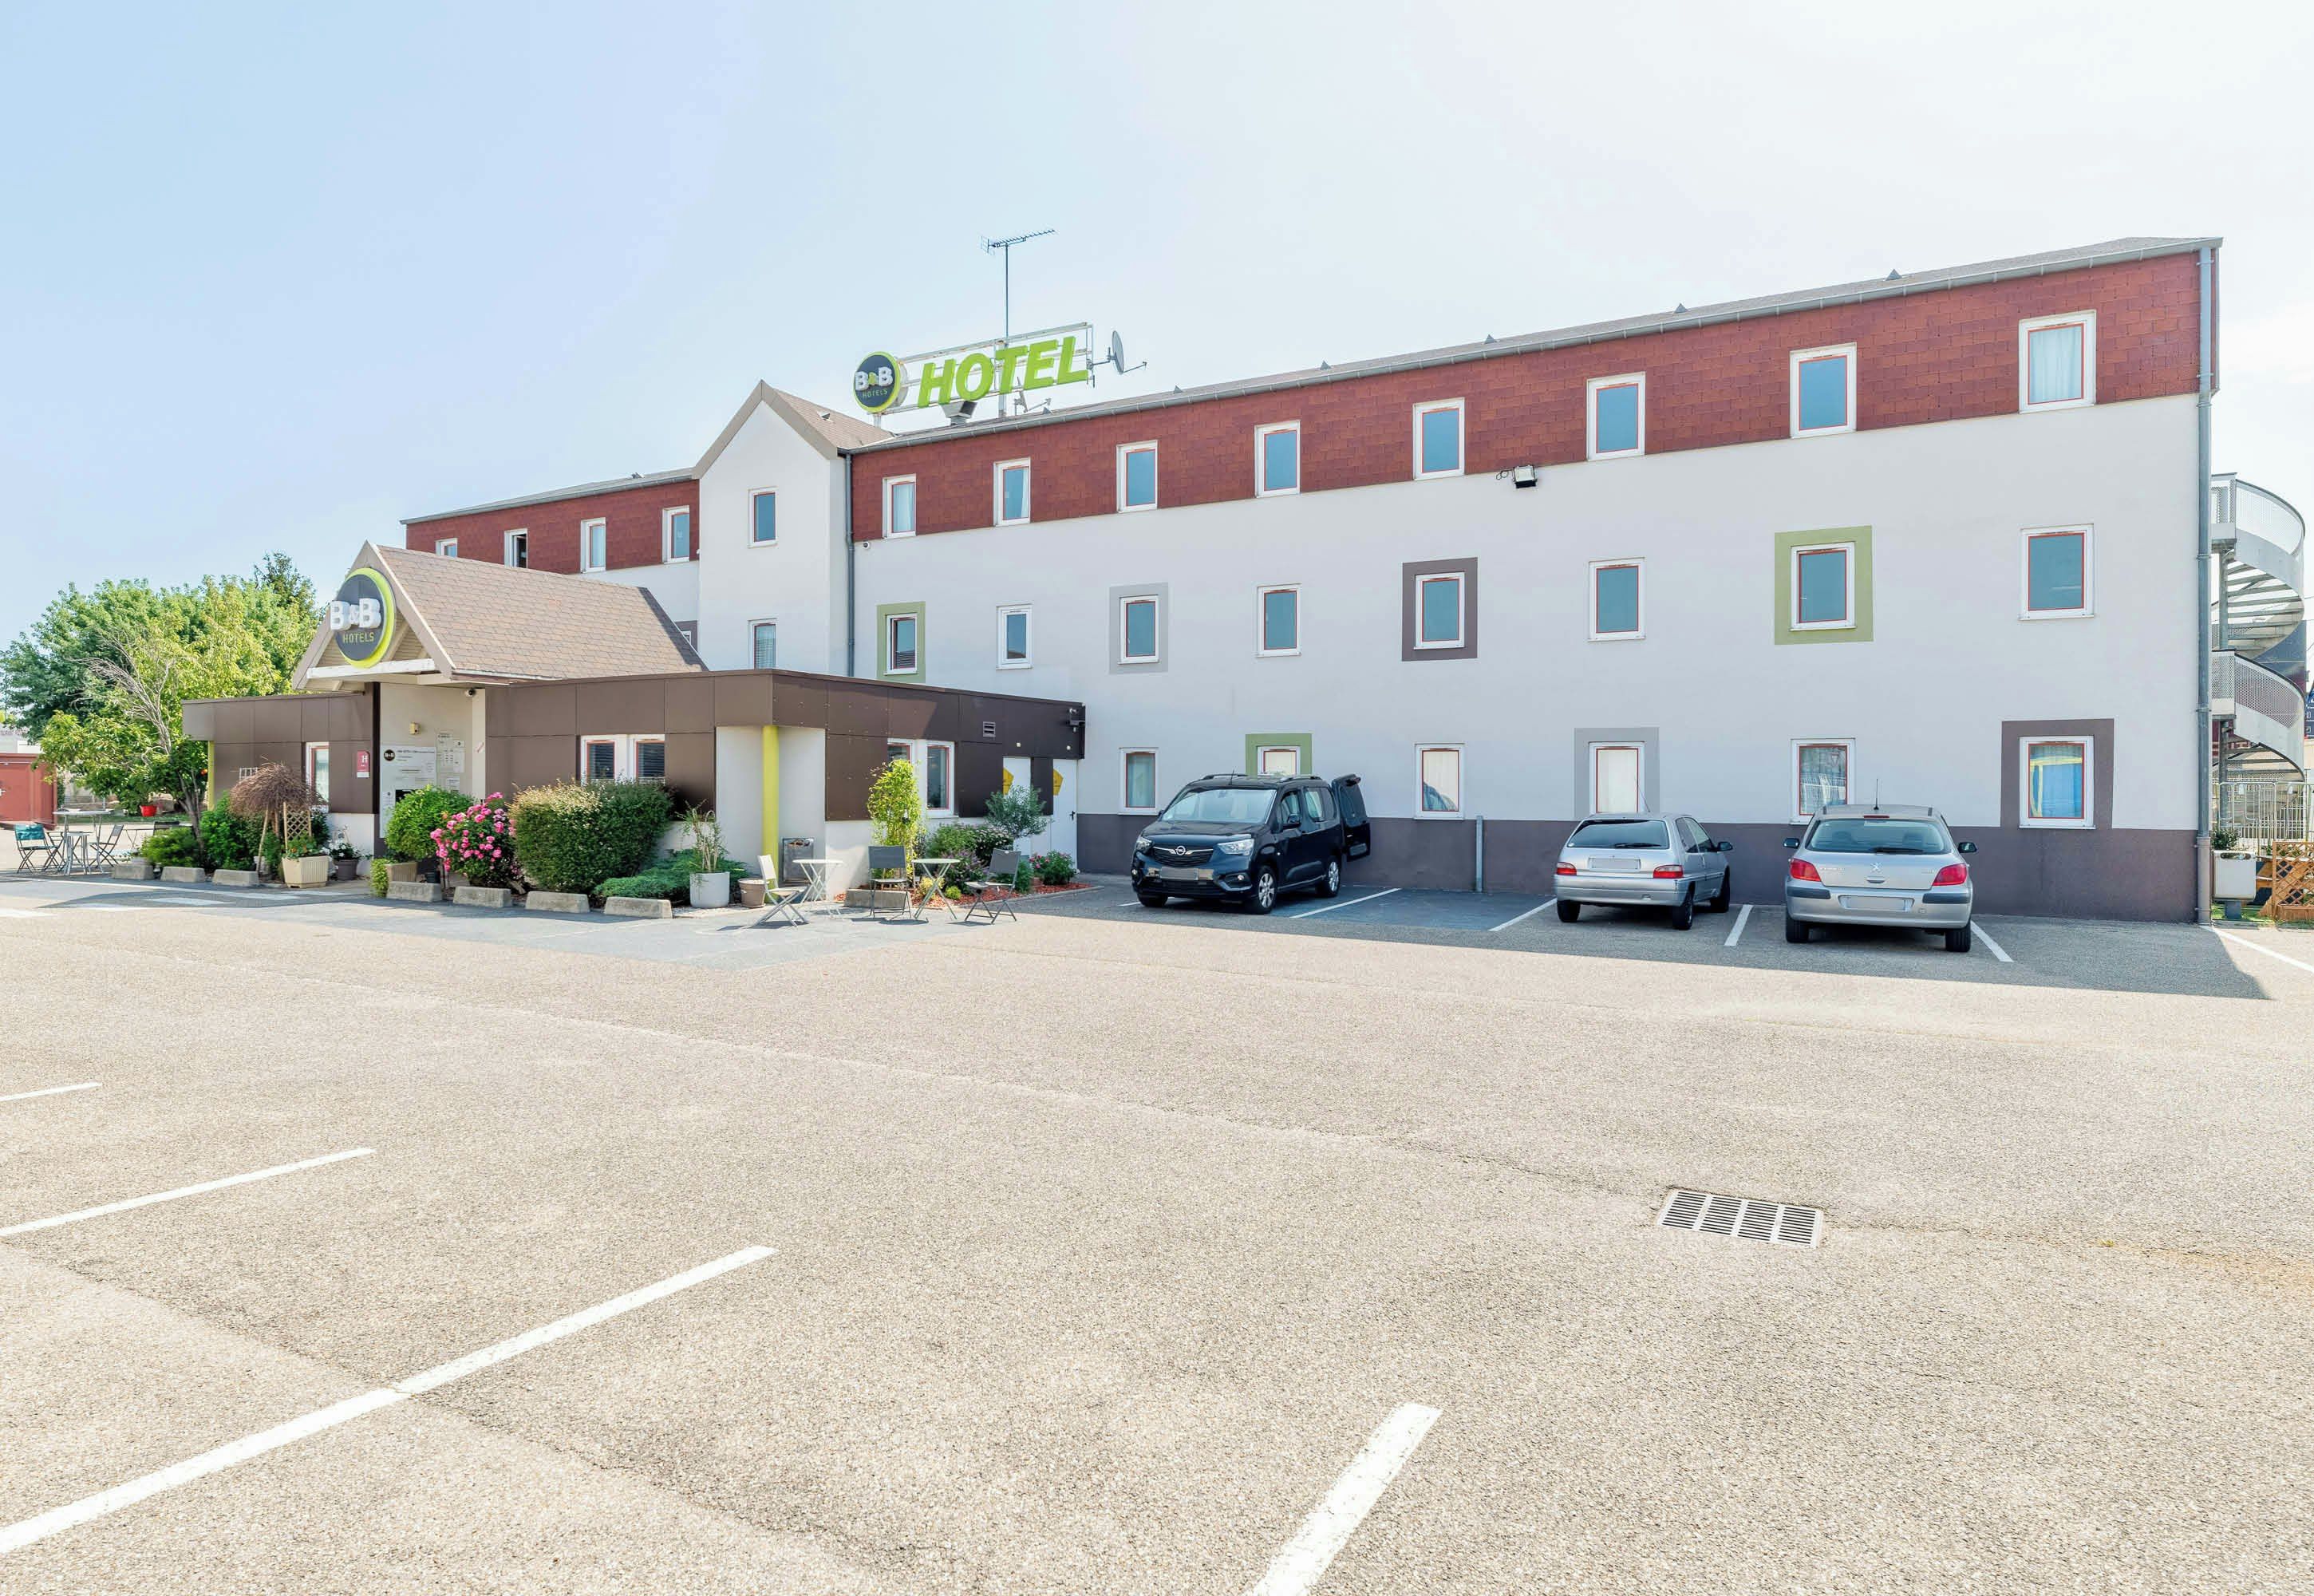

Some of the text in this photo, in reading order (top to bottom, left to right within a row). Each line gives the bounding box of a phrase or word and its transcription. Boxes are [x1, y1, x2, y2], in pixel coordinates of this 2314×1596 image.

[918, 336, 1088, 409] HOTEL
[863, 388, 888, 399] HOTELS
[330, 598, 382, 631] B&B
[342, 631, 374, 643] HOTELS
